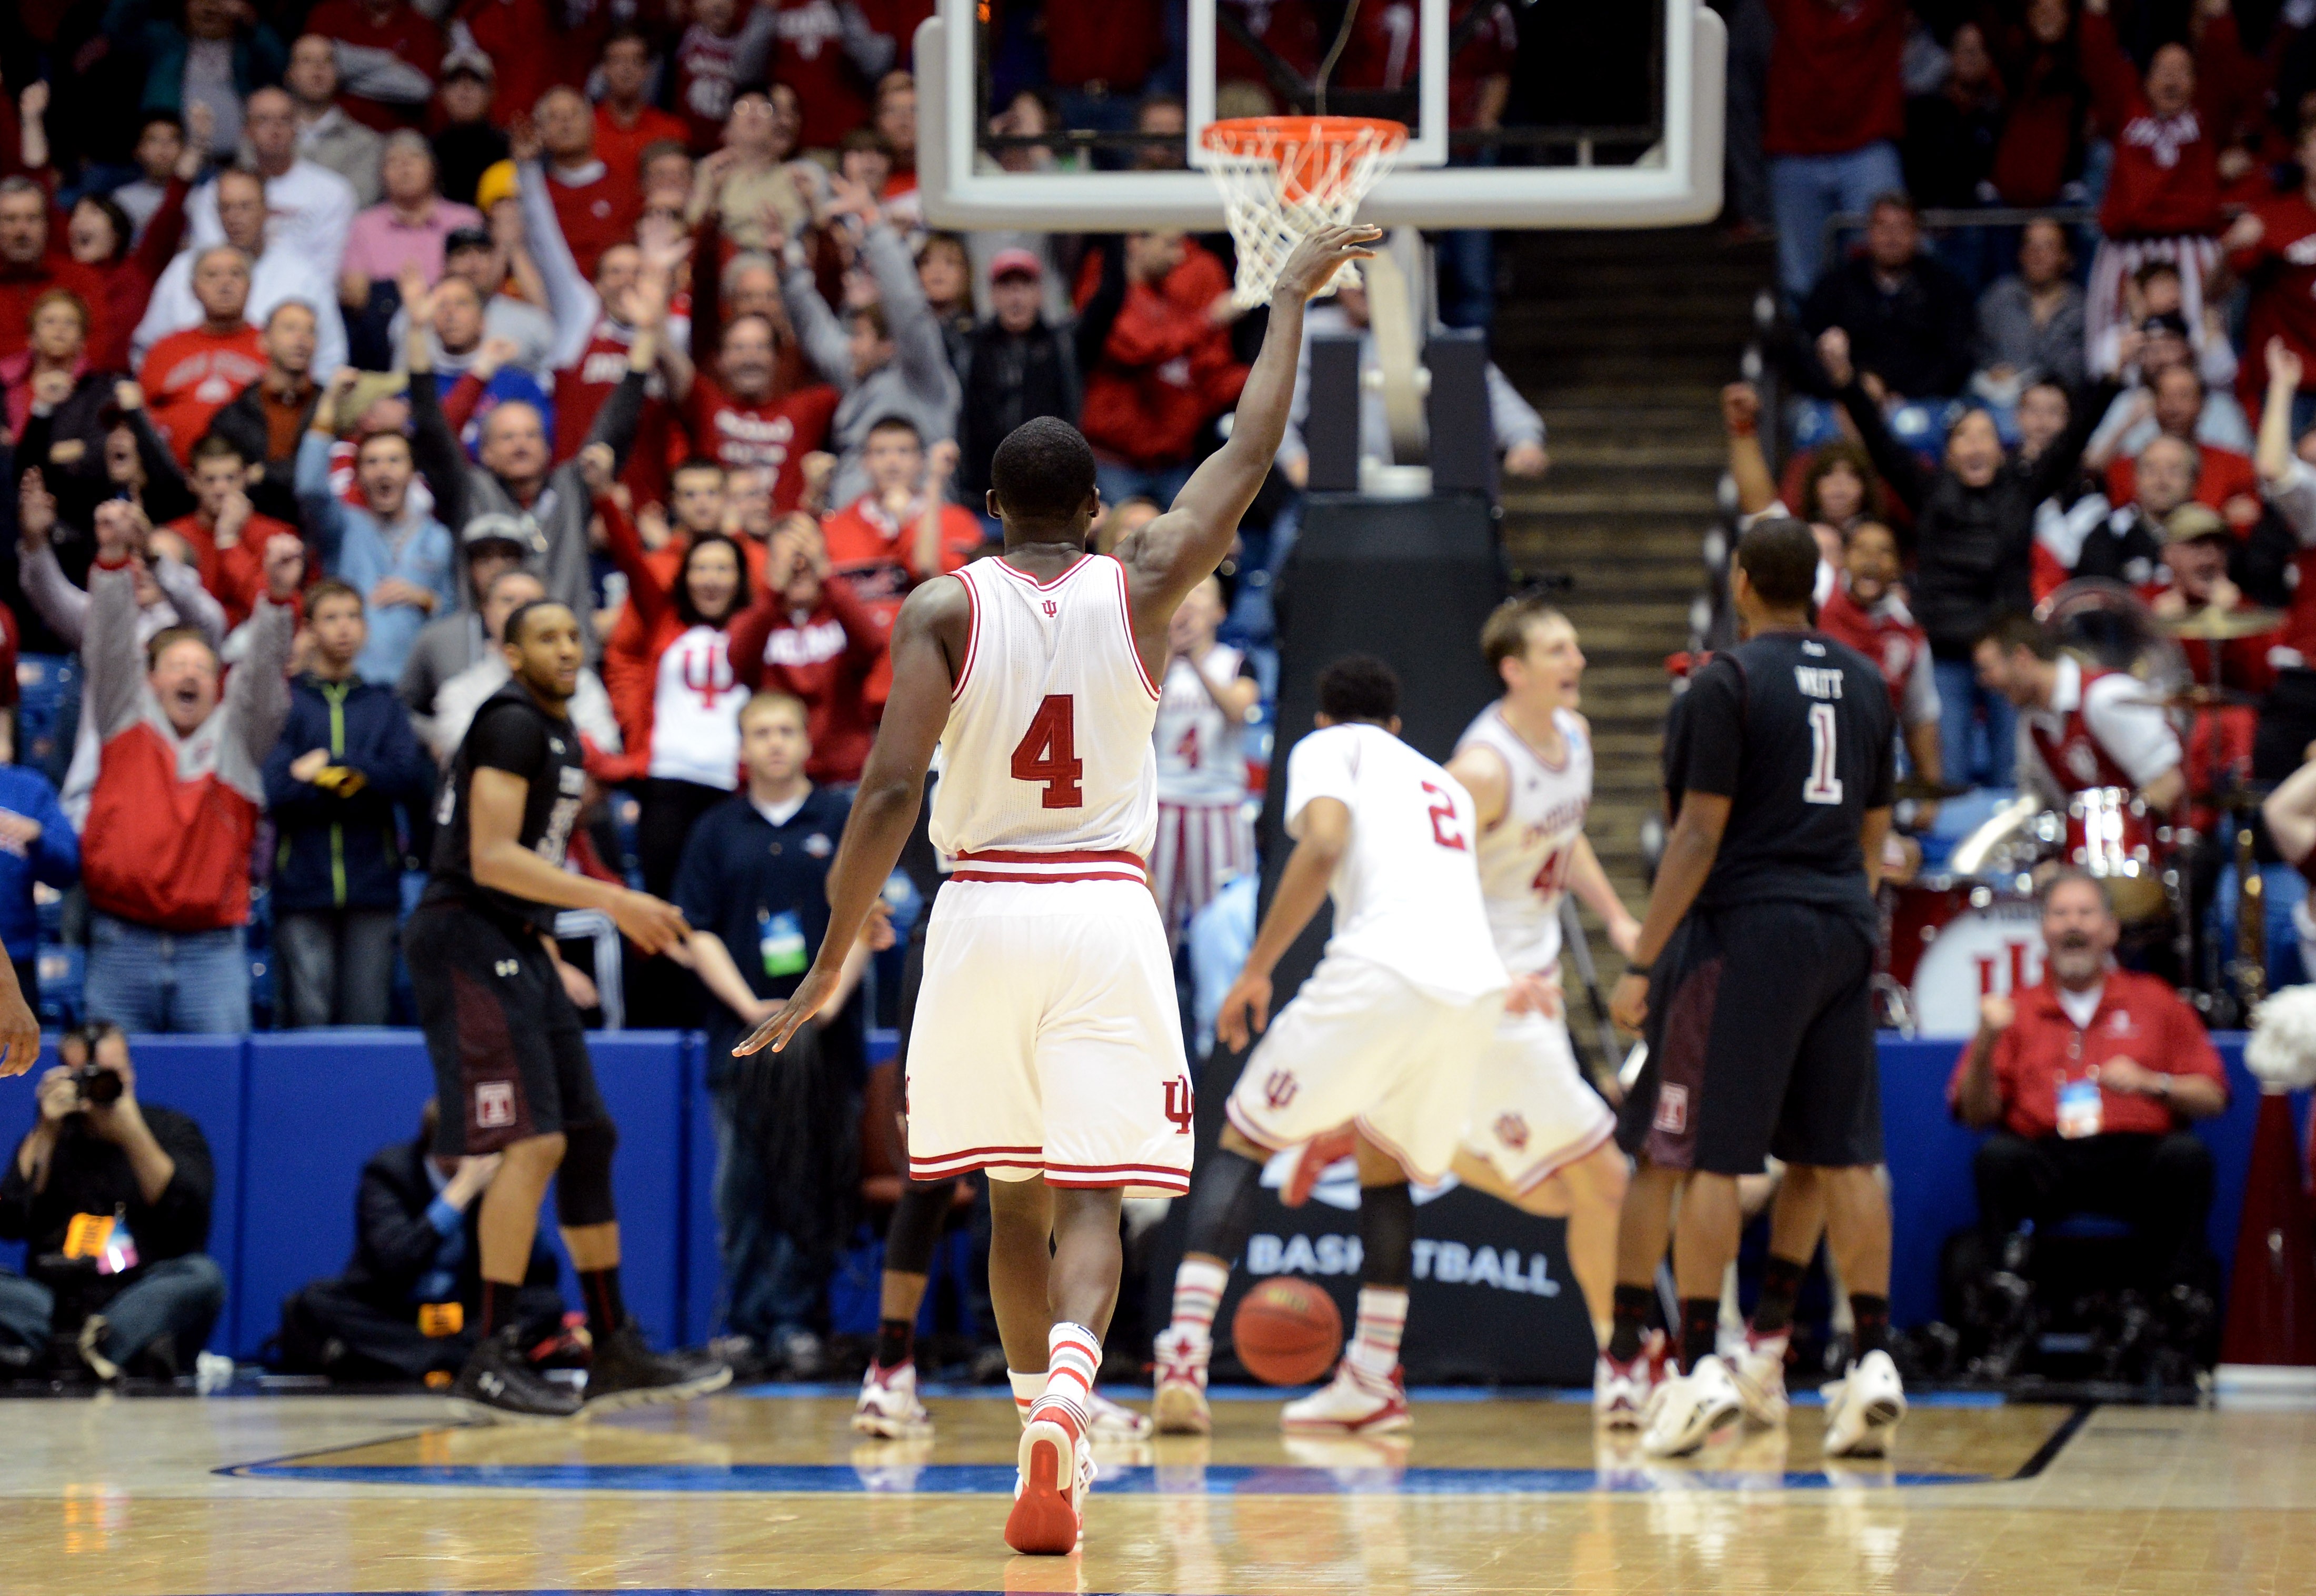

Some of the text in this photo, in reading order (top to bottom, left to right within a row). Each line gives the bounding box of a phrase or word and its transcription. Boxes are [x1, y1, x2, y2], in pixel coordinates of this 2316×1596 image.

[1011, 694, 1083, 809] 4
[1803, 703, 1843, 805] 1
[1420, 781, 1466, 852] 2
[1246, 1233, 1561, 1298] BASTBALL
